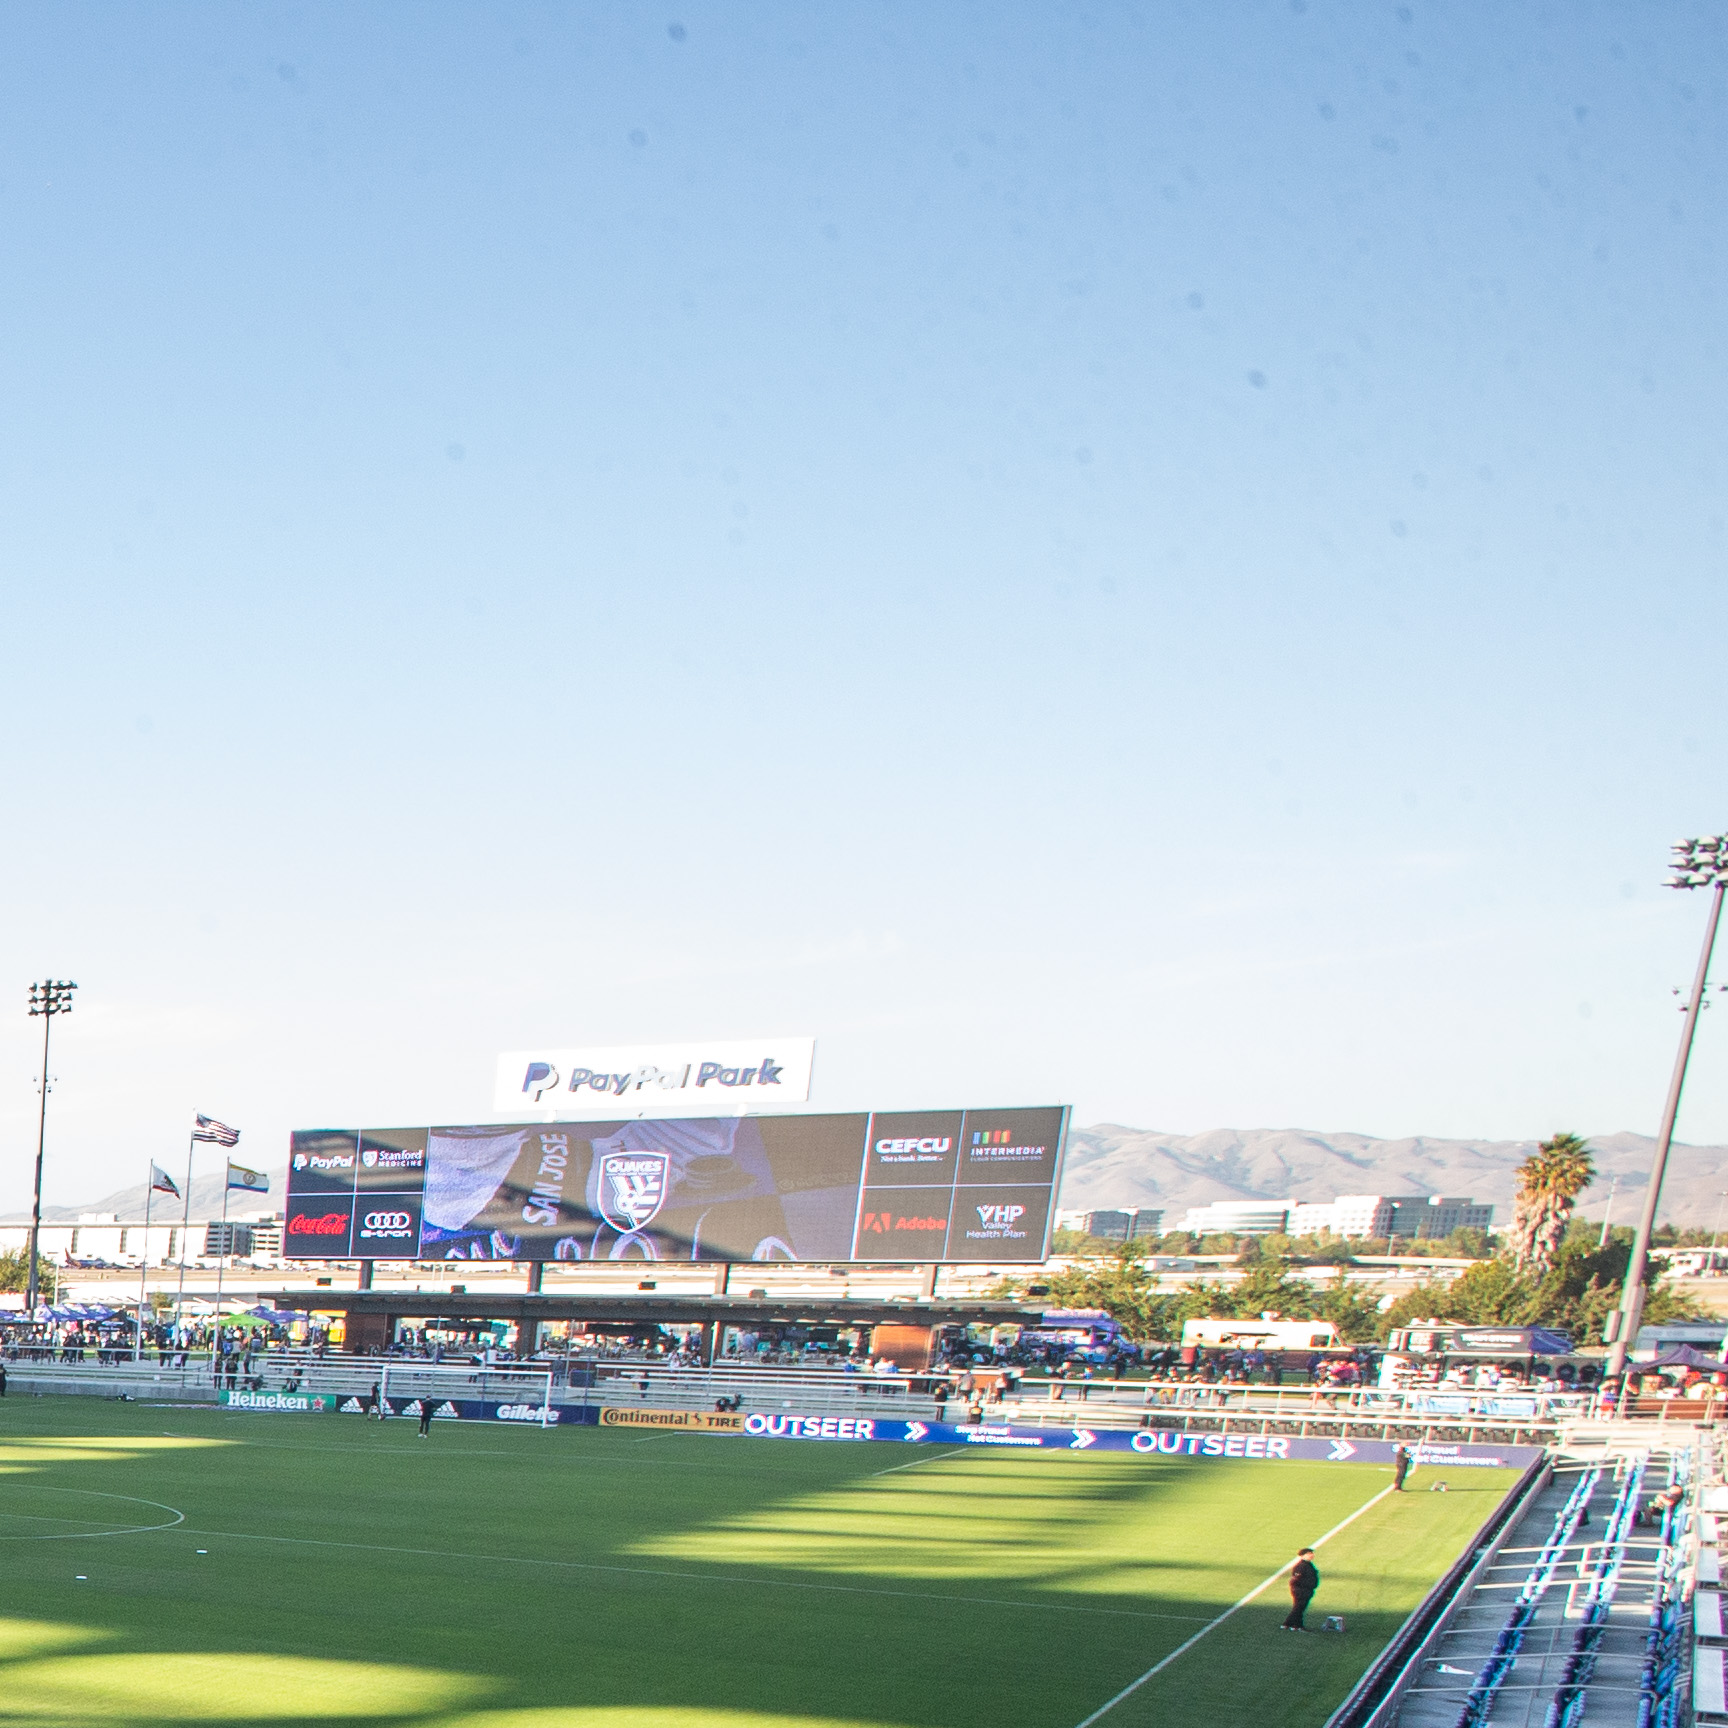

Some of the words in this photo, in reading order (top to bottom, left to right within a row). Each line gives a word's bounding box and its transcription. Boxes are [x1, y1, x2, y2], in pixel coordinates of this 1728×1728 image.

[568, 1063, 692, 1096] PayPal
[696, 1058, 784, 1088] Park
[875, 1137, 952, 1154] CEFCU
[970, 1146, 1043, 1156] INTERMEDIA
[310, 1156, 354, 1169] PayPal
[378, 1150, 424, 1161] Stanford
[538, 1132, 568, 1181] JOSE
[606, 1158, 662, 1173] QUAKES
[522, 1182, 565, 1227] SAN
[976, 1204, 1026, 1223] VHP
[895, 1216, 947, 1230] Adobe
[966, 1230, 1001, 1239] Health
[1003, 1230, 1028, 1238] Plan
[227, 1391, 308, 1410] Heineken
[603, 1408, 688, 1425] Continental
[706, 1416, 741, 1428] TIRE
[744, 1413, 874, 1439] OUTSEER
[1131, 1431, 1291, 1459] OUTSEER
